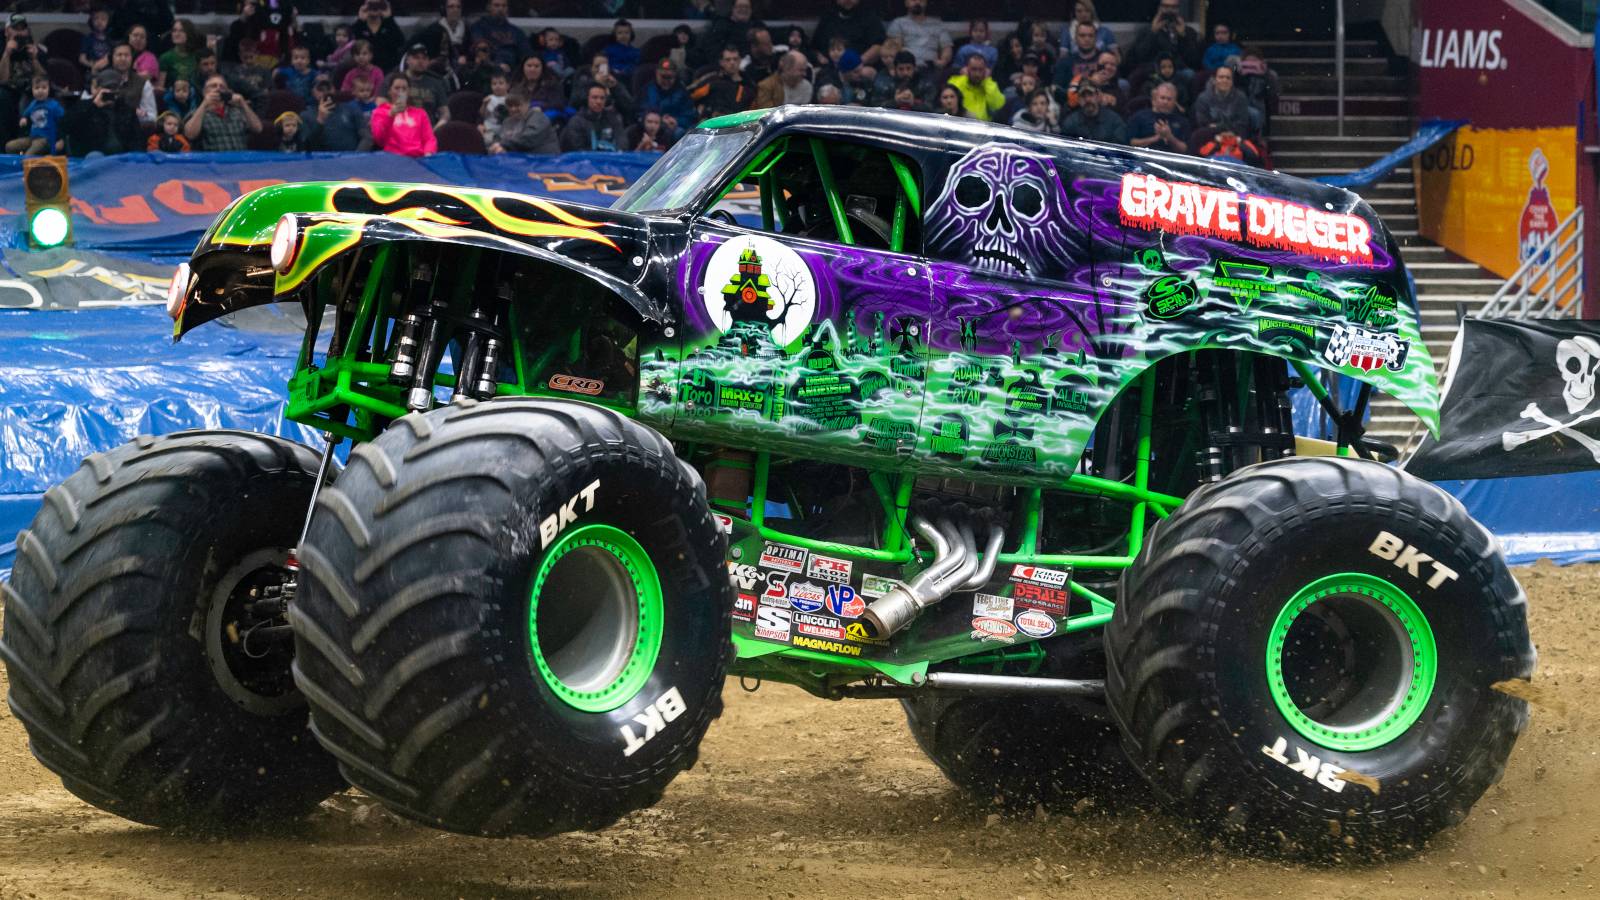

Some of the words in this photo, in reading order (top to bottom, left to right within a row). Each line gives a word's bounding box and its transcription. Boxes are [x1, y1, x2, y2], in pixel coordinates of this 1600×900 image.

[1120, 173, 1241, 236] GRAVE
[1246, 193, 1372, 260] DIGGER
[1155, 292, 1187, 308] SPIN
[1158, 300, 1188, 315] MASTER
[1258, 319, 1314, 338] MONSTERJAM.COM
[954, 366, 980, 381] ADAM
[682, 383, 712, 405] Toro
[721, 386, 763, 403] MAX-D
[953, 387, 980, 405] RYAN
[1056, 386, 1089, 403] ALIEN
[1056, 401, 1087, 412] INVASION
[984, 442, 1034, 460] MONSTER
[539, 479, 600, 550] BKT
[766, 545, 803, 562] OPTIMA
[1368, 530, 1459, 590] BKT
[815, 558, 849, 573] FK
[819, 568, 849, 579] ROD
[808, 572, 849, 584] ENDS
[1034, 570, 1065, 582] KING
[794, 590, 821, 601] LUCAS
[829, 584, 856, 616] VP
[1016, 583, 1065, 603] DERALE
[1015, 597, 1064, 610] PERFORMANCE
[795, 613, 838, 628] LINCOLN
[1020, 617, 1036, 627] TOTAL
[1037, 619, 1051, 629] SEAL
[756, 628, 788, 641] SIMPSON
[803, 625, 840, 638] WELDERS
[793, 636, 862, 656] MAGNAFLOW
[619, 686, 687, 757] BKT
[1261, 736, 1347, 793] BKT
